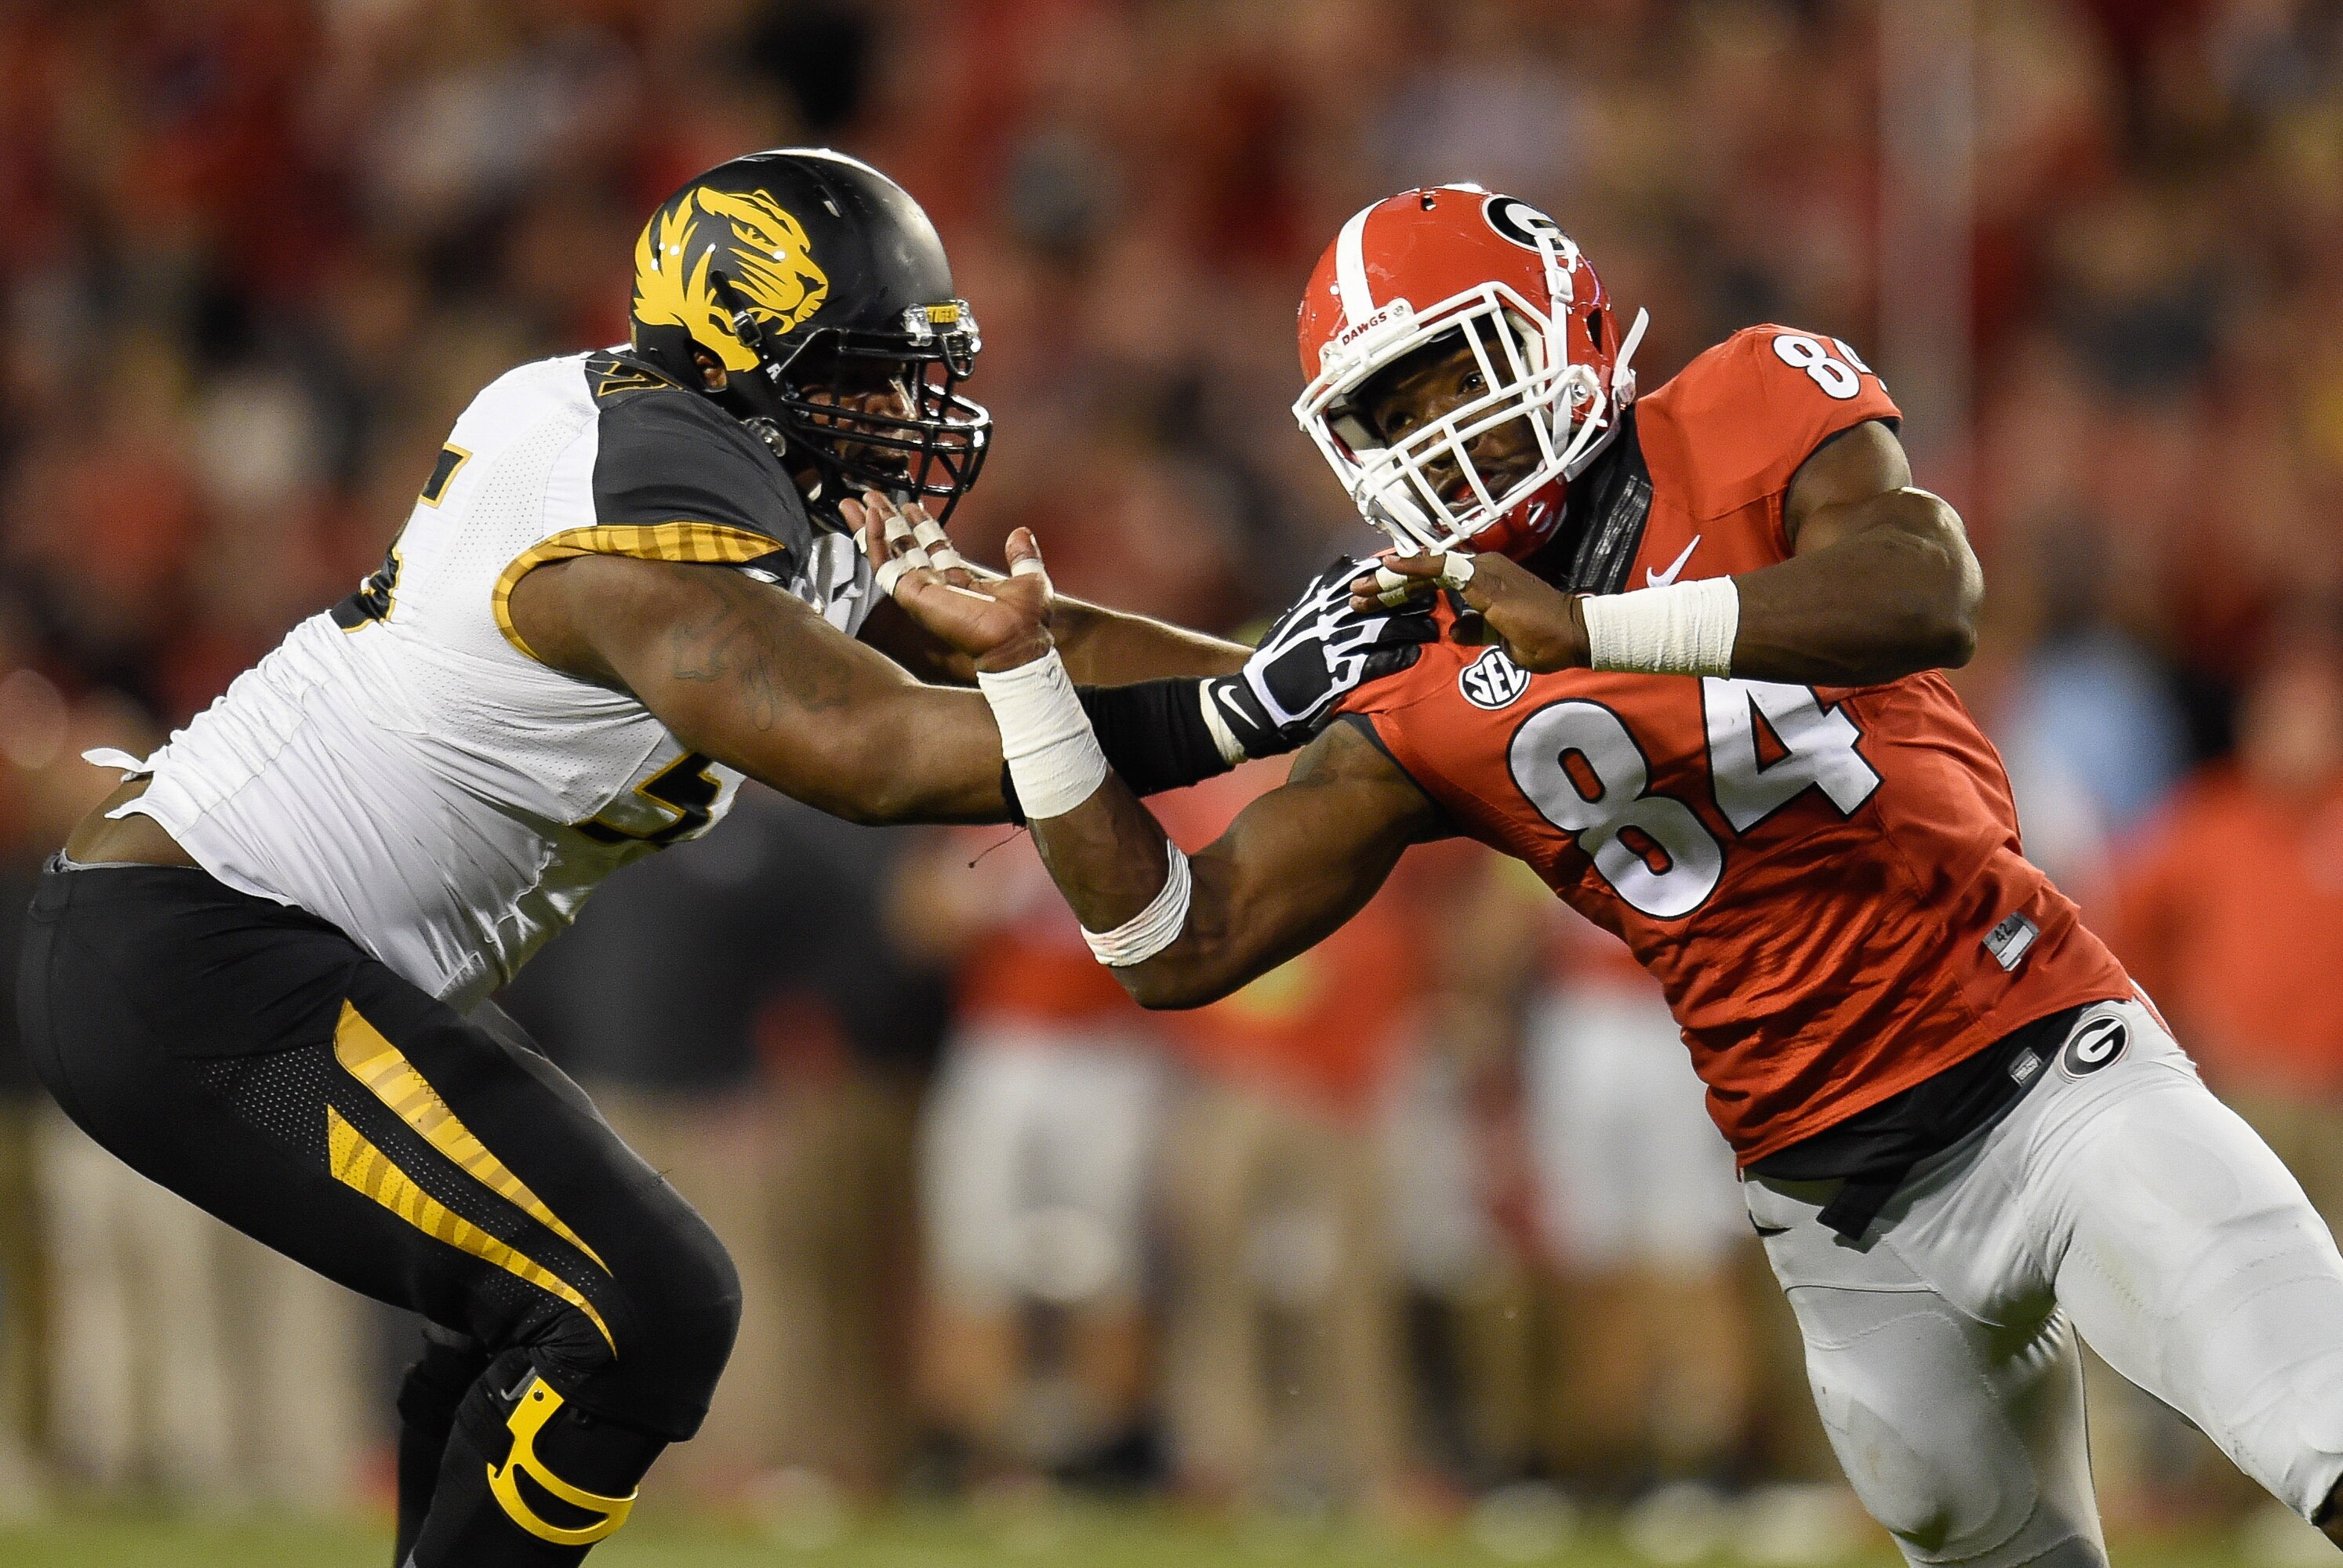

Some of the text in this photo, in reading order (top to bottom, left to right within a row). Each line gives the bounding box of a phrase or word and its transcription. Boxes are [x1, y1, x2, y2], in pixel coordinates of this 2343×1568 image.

[1342, 311, 1387, 346] DAWGS
[1506, 676, 1885, 920] 84
[1994, 923, 2013, 942] 42
[2064, 1018, 2127, 1075] G
